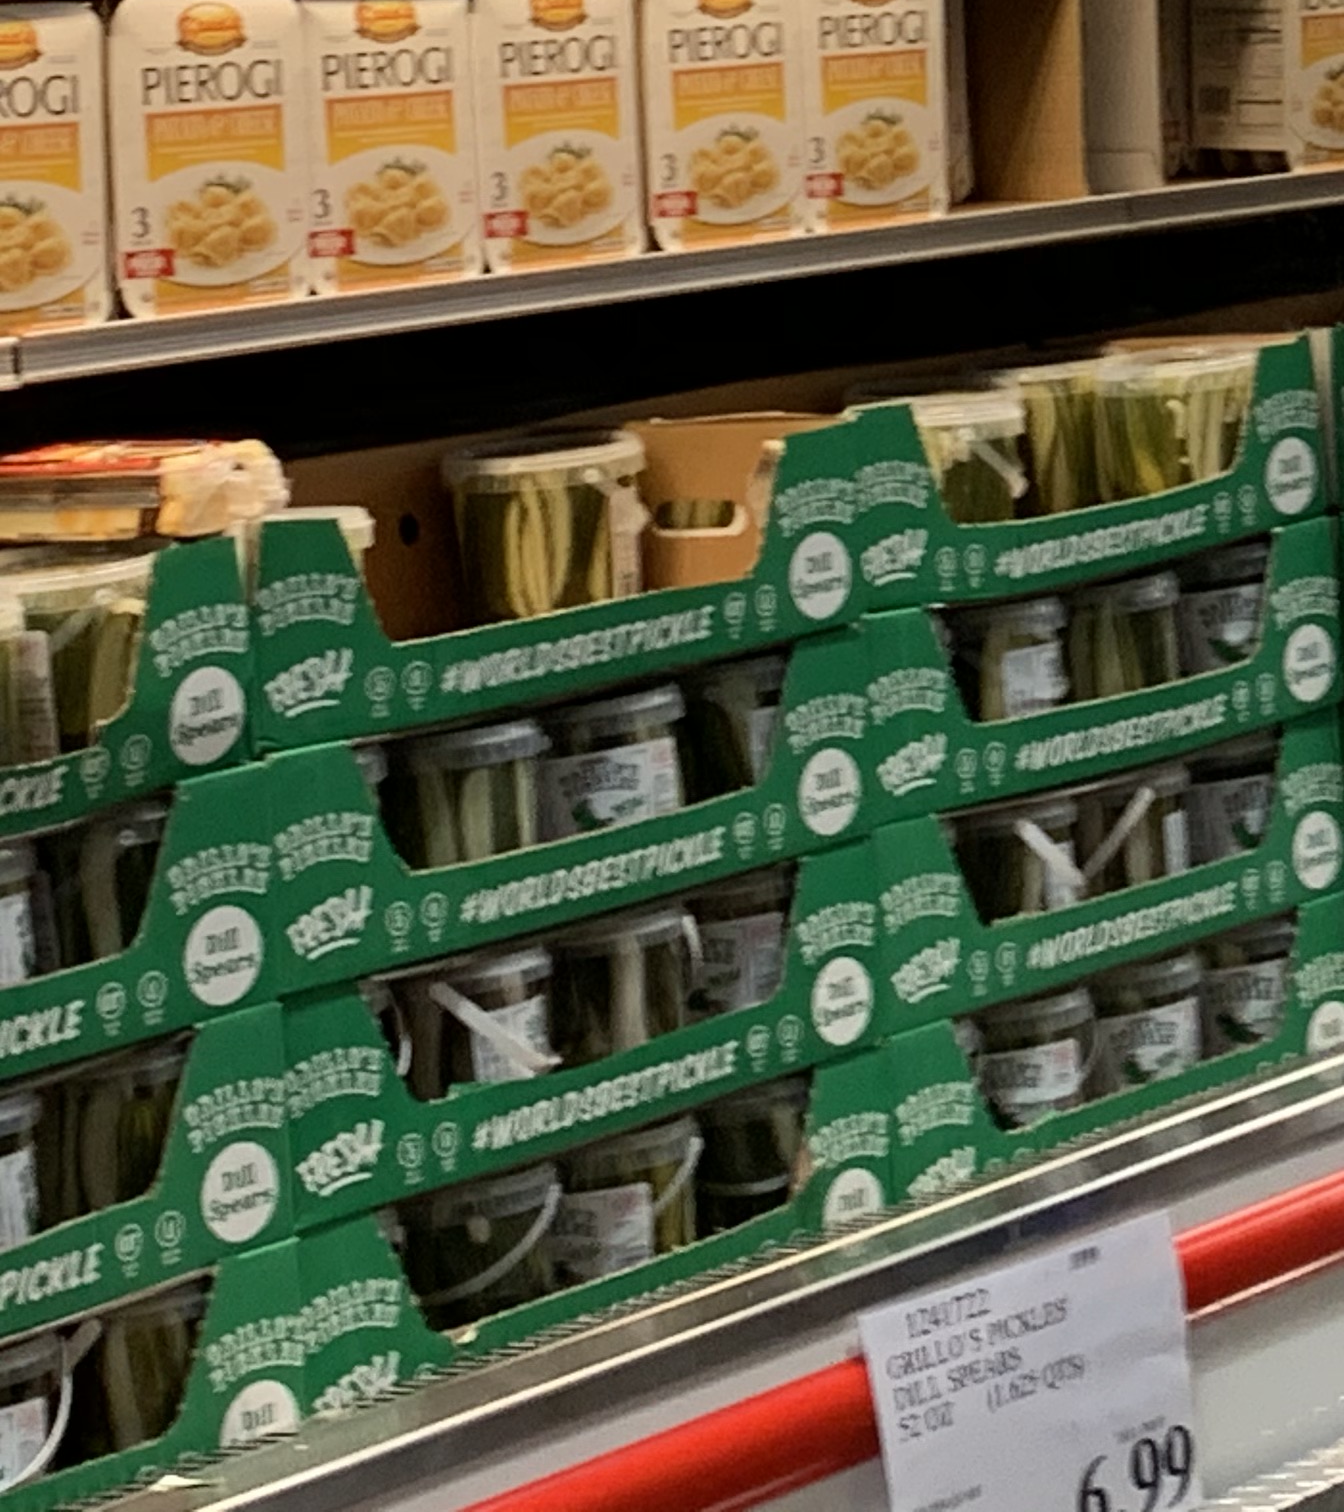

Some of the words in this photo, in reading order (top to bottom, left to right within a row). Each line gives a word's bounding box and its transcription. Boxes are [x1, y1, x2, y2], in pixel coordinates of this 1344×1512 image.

[667, 22, 783, 62] PIEROGI
[818, 10, 929, 49] PIEROGI
[321, 46, 456, 91] PIEROGI
[500, 34, 619, 78] PIEROGI
[141, 58, 283, 106] PIEROGI
[131, 206, 150, 239] 3
[311, 188, 331, 219] 3
[886, 1328, 984, 1380] GRILLO'S
[985, 1296, 1069, 1346] PICKLES
